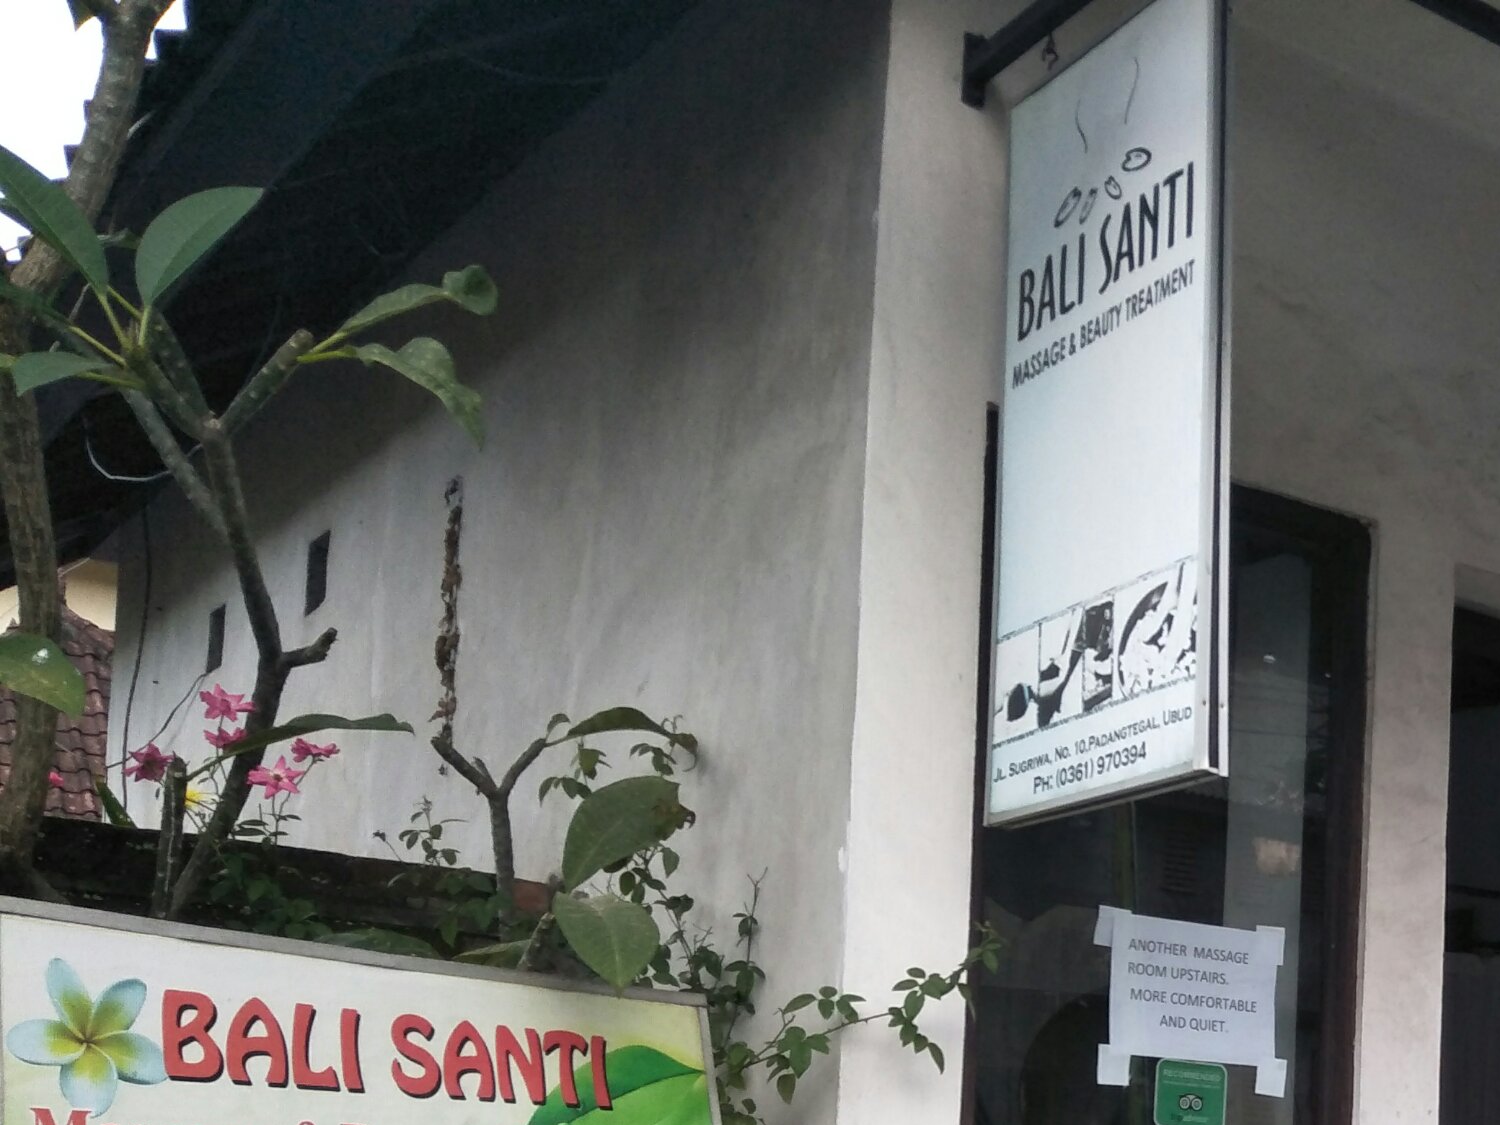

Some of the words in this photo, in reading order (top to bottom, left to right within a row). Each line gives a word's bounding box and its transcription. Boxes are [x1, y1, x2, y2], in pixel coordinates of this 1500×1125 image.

[1017, 232, 1085, 342] BALI
[1098, 161, 1194, 294] SANTI
[1012, 338, 1066, 389] MASSAGE
[1069, 333, 1077, 356] &
[1080, 302, 1122, 348] BEAUTY
[1125, 259, 1195, 322] TREATMENT
[1055, 760, 1094, 787] (0361)
[1097, 741, 1146, 775] 970394
[1128, 939, 1187, 957] ANOTHER
[1193, 946, 1249, 964] MASSAGE
[1128, 962, 1167, 978] ROOM
[1171, 968, 1229, 985] UPSTAIRS.
[1130, 988, 1167, 1003] MORE
[1170, 992, 1257, 1013] COMFORTABLE
[1160, 1015, 1186, 1029] AND
[161, 989, 365, 1094] BALI
[390, 1014, 614, 1111] SANTI
